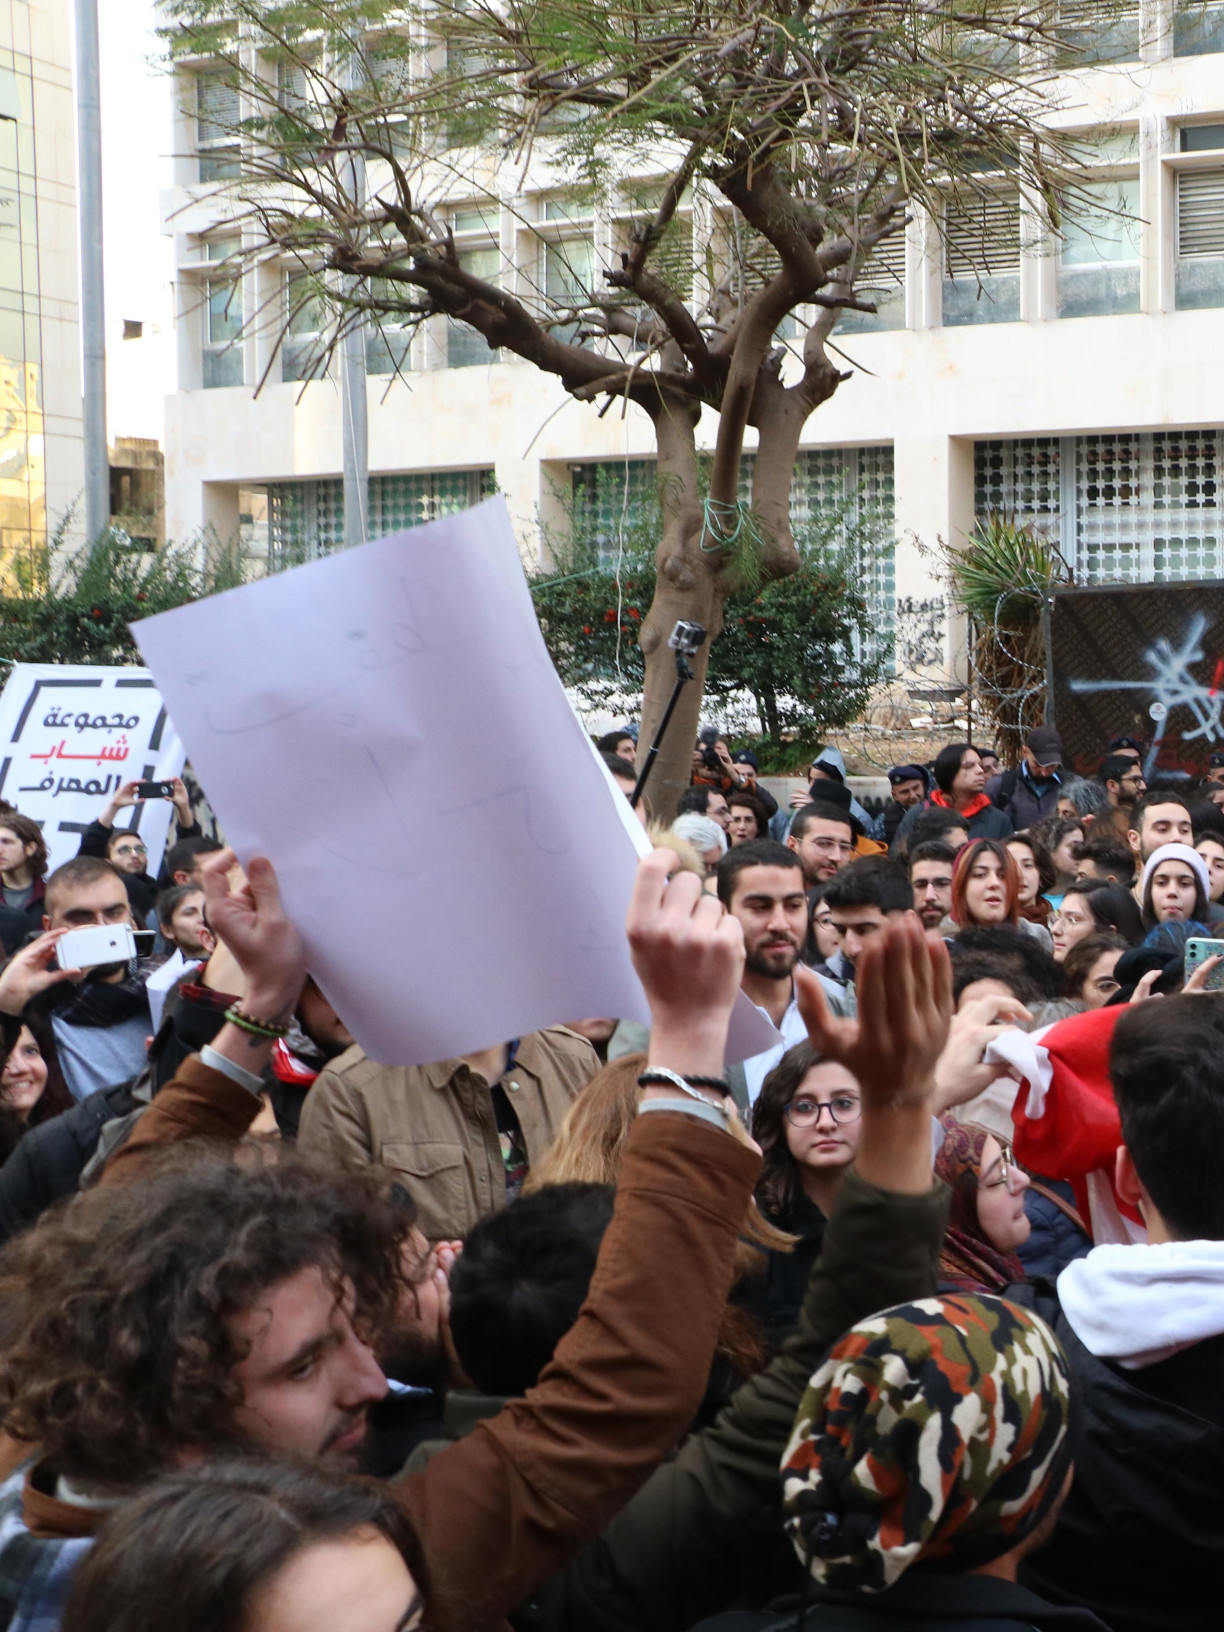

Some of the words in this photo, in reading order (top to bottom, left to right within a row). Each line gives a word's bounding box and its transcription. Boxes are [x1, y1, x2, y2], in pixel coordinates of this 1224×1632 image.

[43, 706, 141, 734] مجموعة
[30, 735, 130, 766] شباب
[19, 770, 122, 797] المصرف
